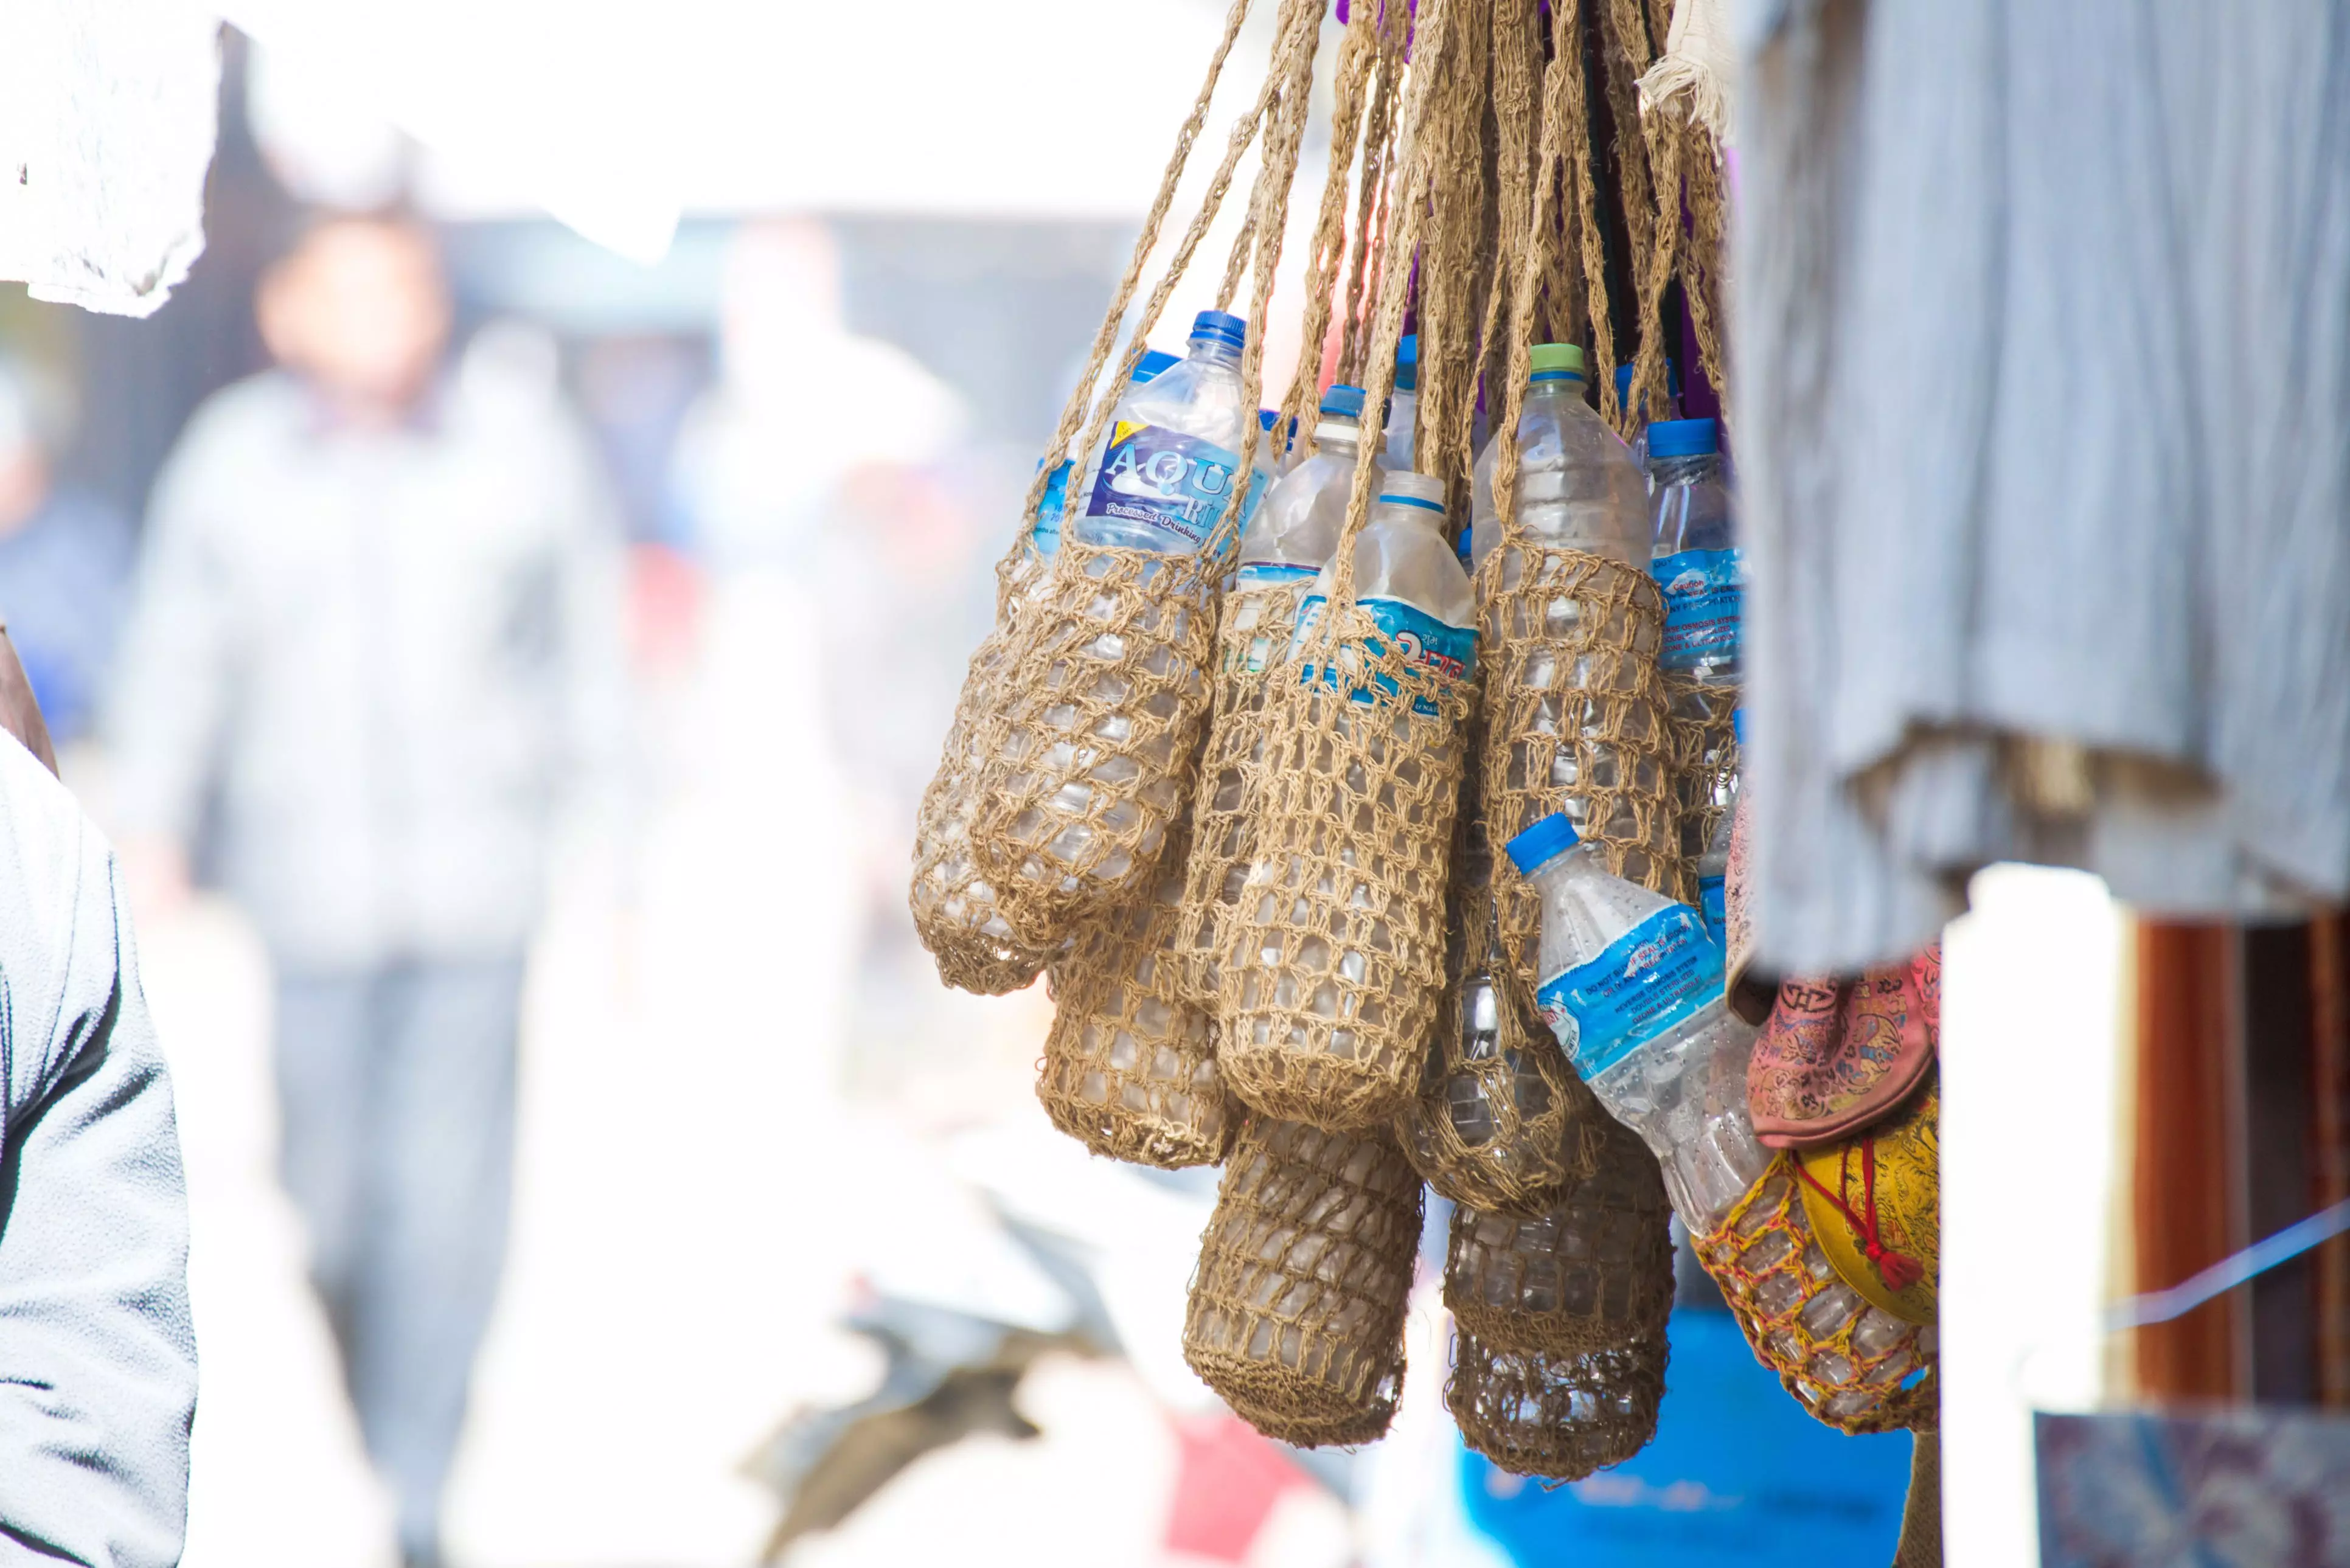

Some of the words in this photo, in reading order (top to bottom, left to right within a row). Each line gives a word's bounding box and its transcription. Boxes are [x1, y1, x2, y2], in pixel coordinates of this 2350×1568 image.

[1107, 502, 1158, 521] Processed
[1160, 515, 1201, 546] Drinking
[1674, 580, 1705, 592] Caution
[1681, 619, 1716, 631] OSMOSIS
[1585, 983, 1597, 996] DO
[1597, 973, 1615, 988] NOT
[1638, 945, 1658, 960] SEAL
[1630, 993, 1660, 1015] DOUBLE
[1632, 1005, 1656, 1025] OZONE
